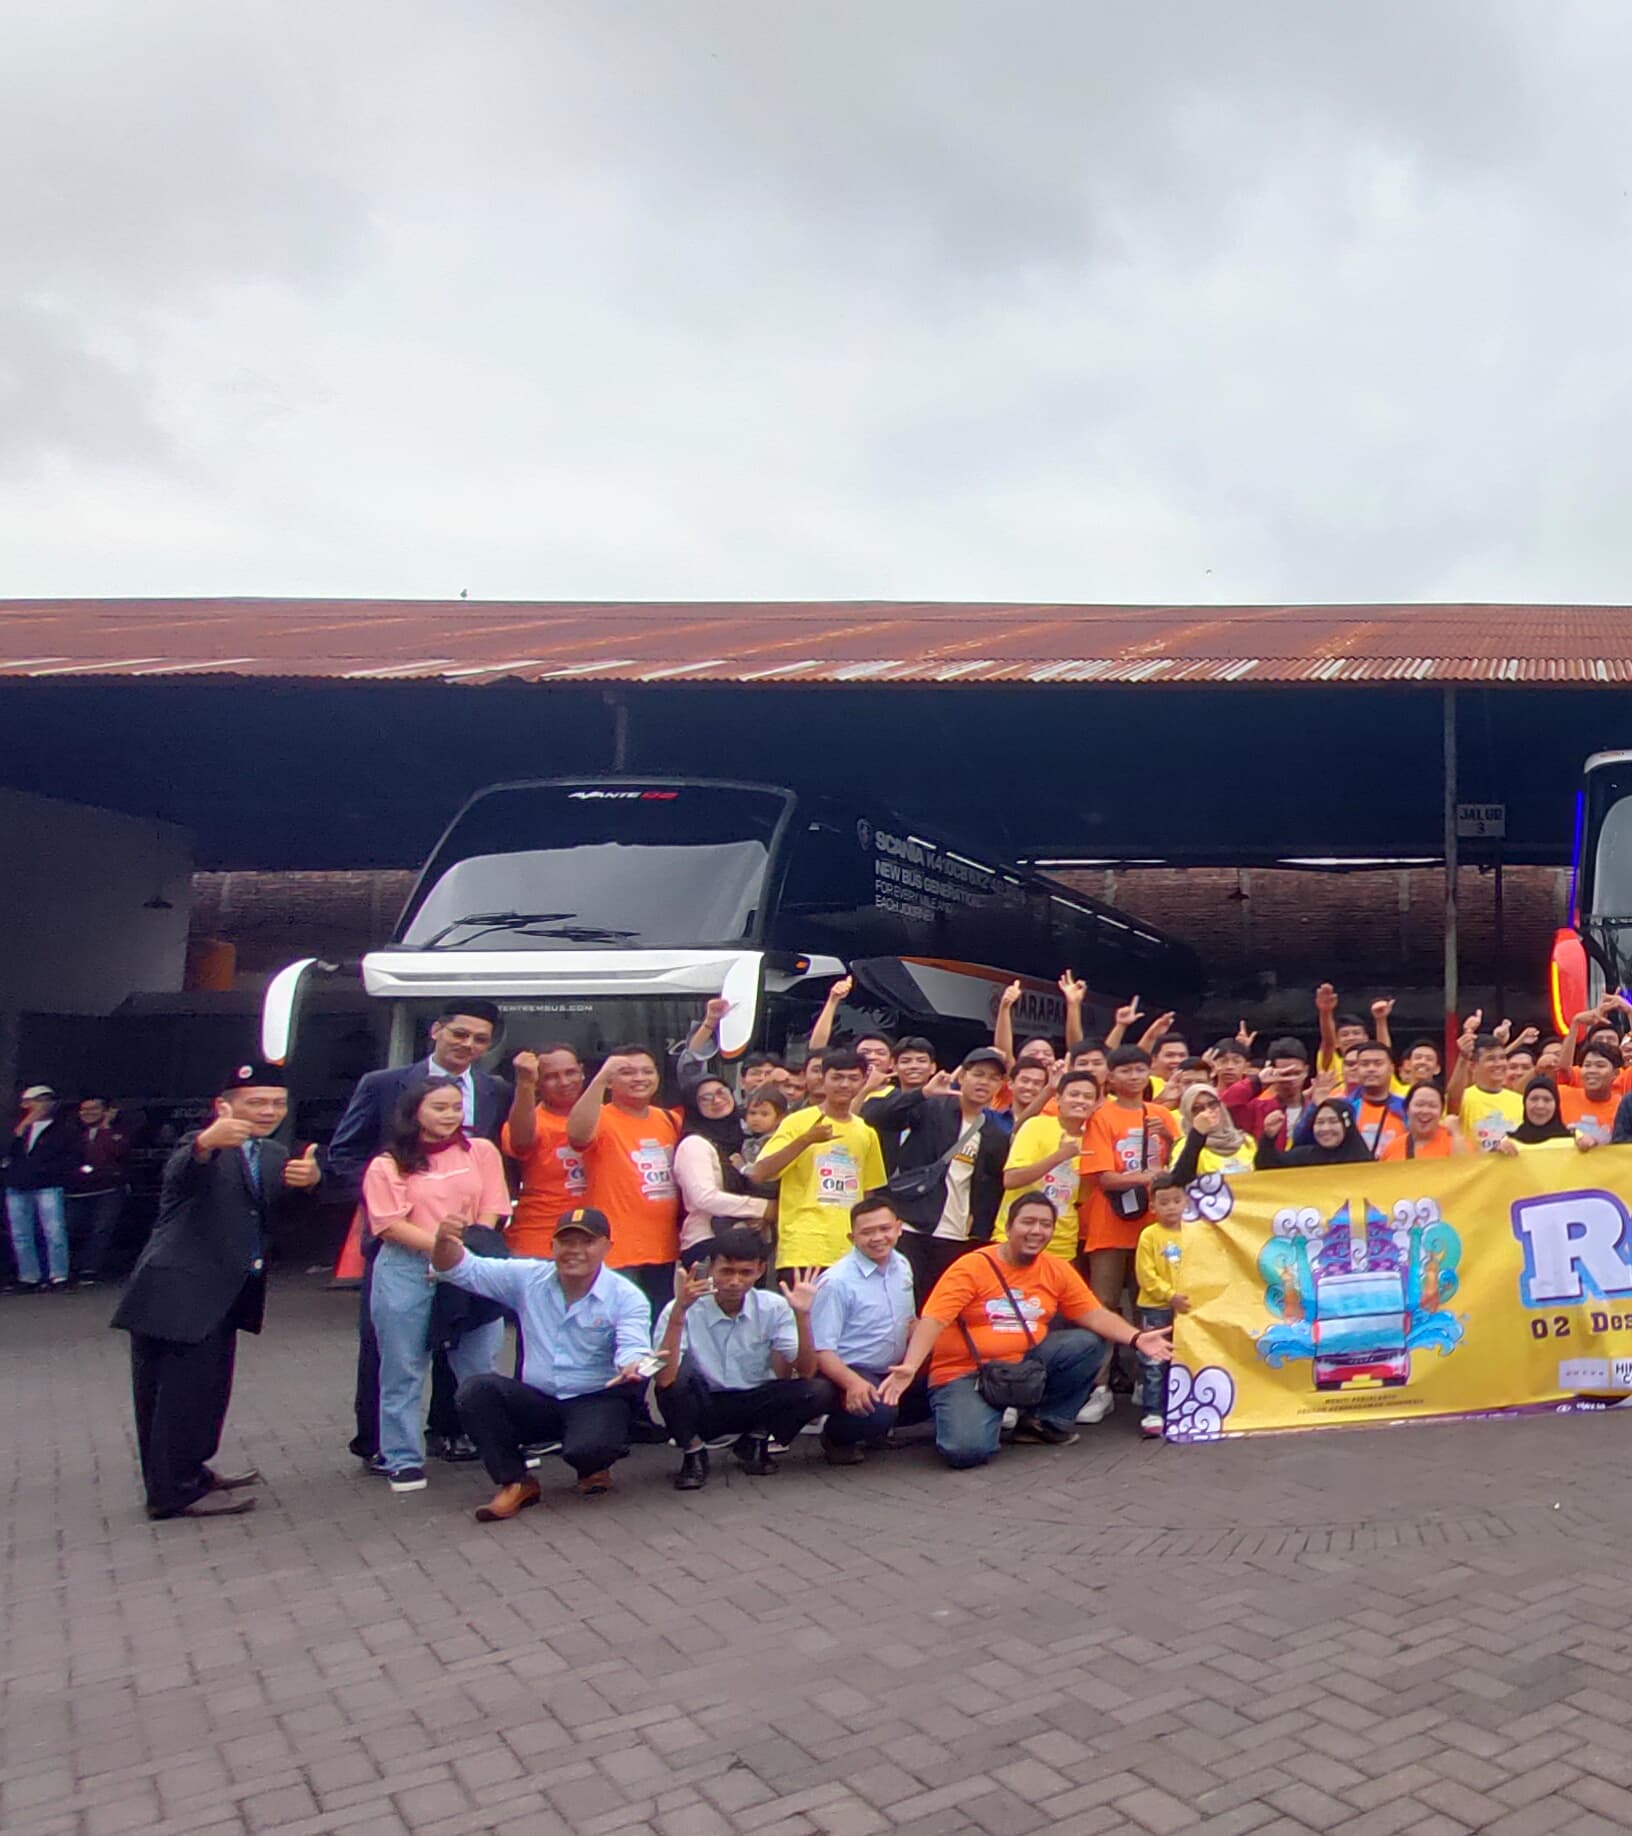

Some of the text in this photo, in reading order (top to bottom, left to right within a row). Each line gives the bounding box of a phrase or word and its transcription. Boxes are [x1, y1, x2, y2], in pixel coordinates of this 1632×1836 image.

[874, 831, 924, 868] SCANIA
[874, 859, 900, 882] NEW
[901, 867, 922, 890] BUS
[874, 880, 893, 897] FOR
[498, 1004, 594, 1012] TENTREMBUS.COM
[1530, 1315, 1572, 1340] 02
